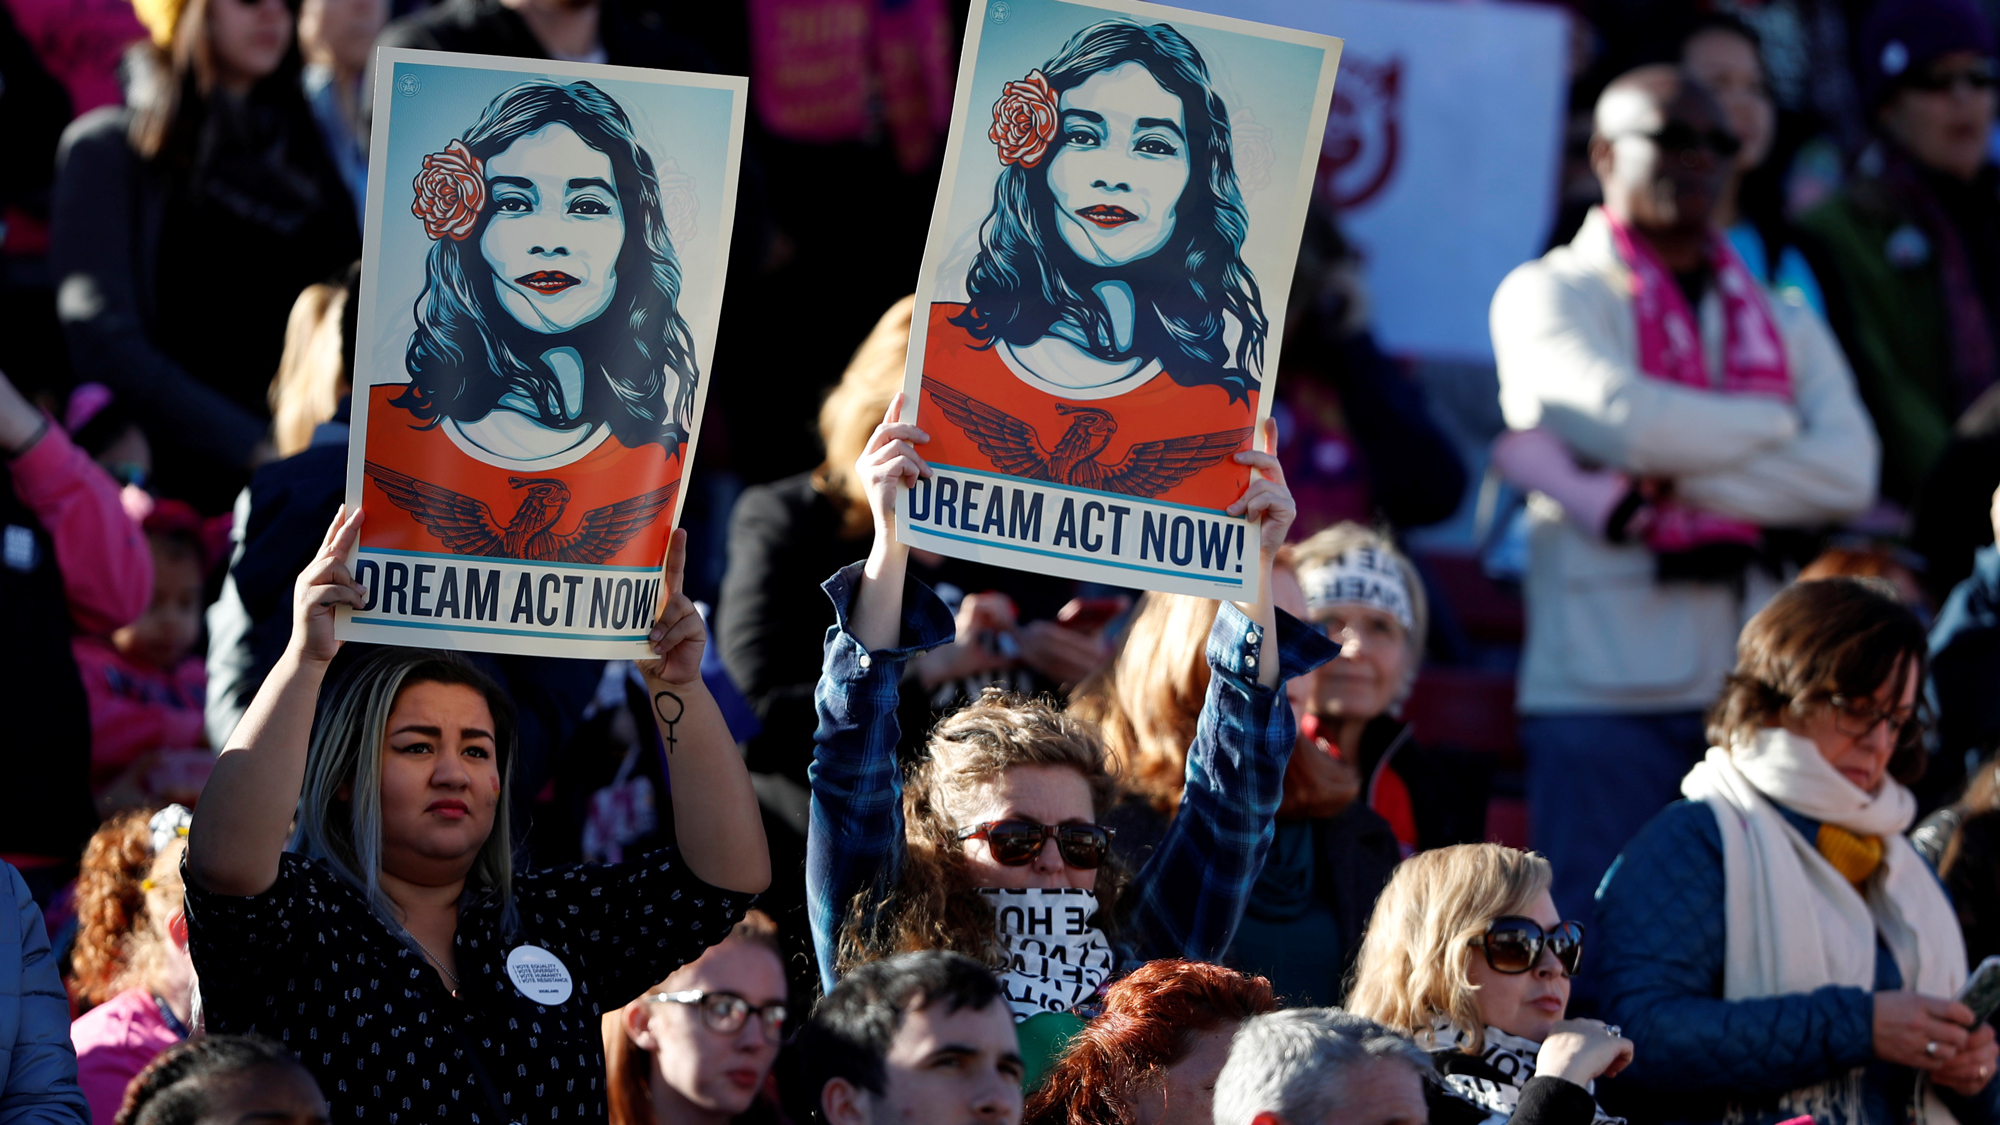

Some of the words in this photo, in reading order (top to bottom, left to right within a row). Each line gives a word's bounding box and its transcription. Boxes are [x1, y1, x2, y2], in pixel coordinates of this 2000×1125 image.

[908, 474, 1045, 543] DREAM
[1052, 496, 1131, 556] ACT
[1139, 510, 1246, 573] NOW!
[352, 558, 502, 622] DREAM
[509, 571, 584, 627] ACT
[587, 576, 661, 630] NOW!
